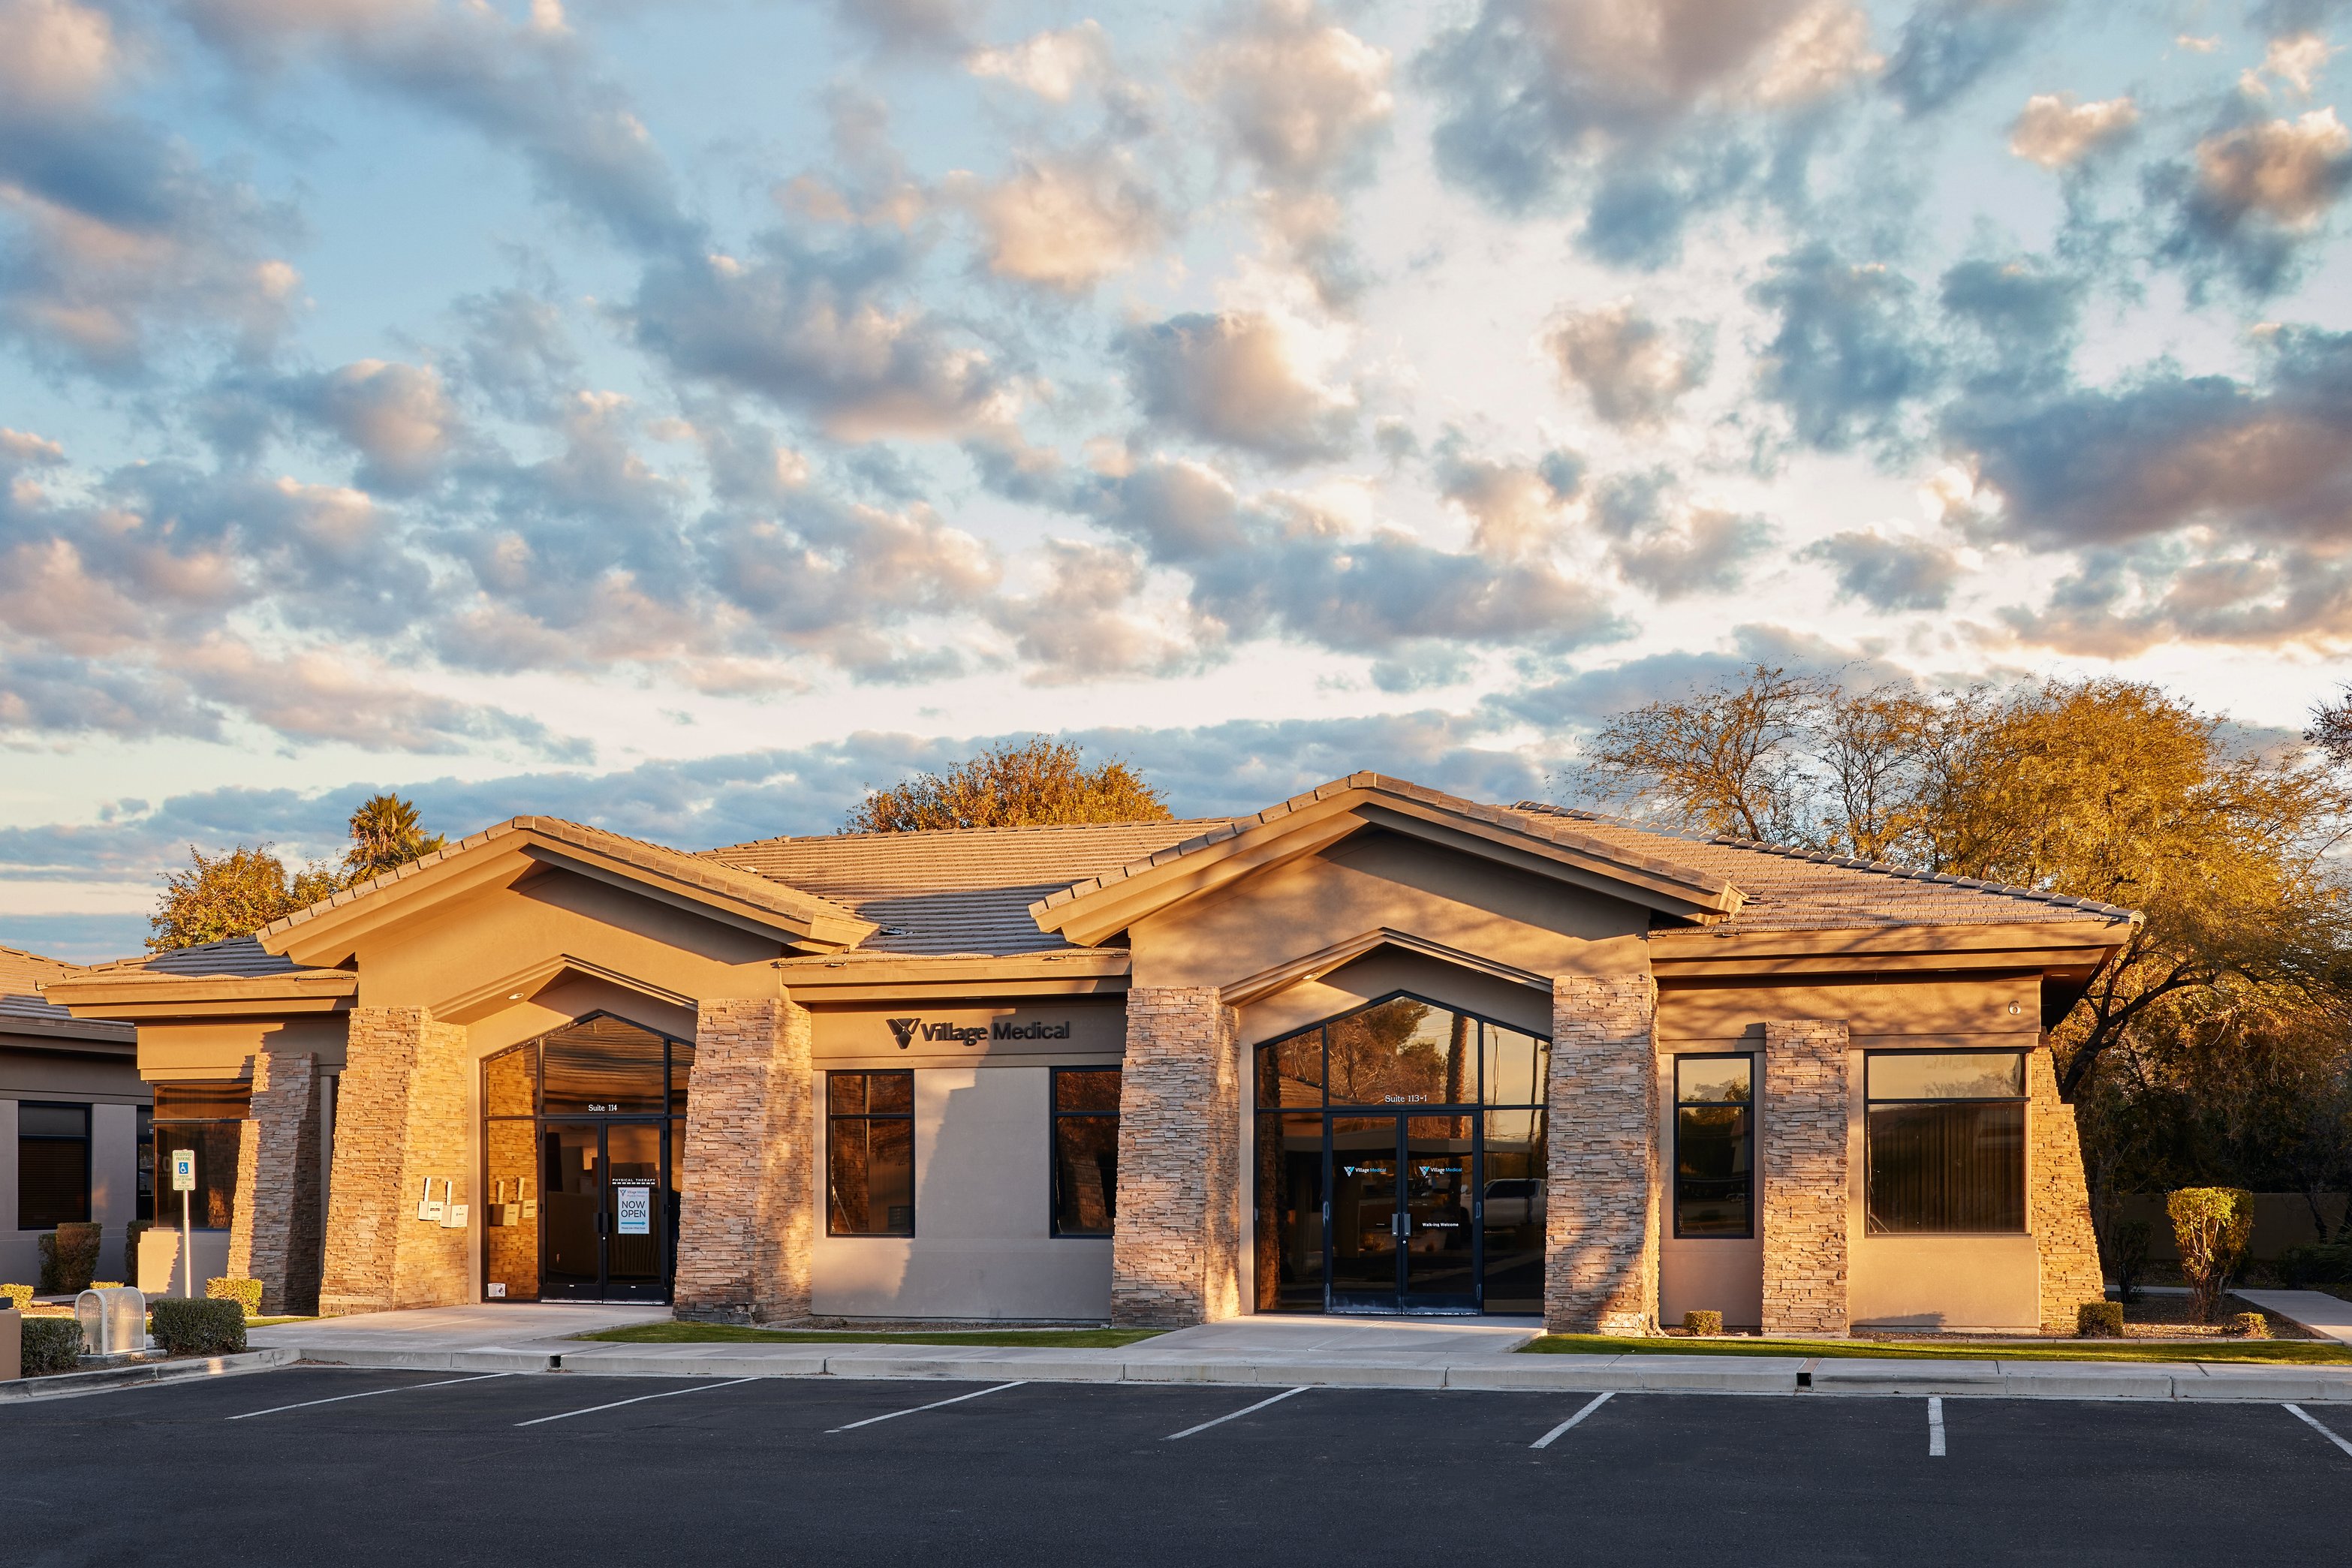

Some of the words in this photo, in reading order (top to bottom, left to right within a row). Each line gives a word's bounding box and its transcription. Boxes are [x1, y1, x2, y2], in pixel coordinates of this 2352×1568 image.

[2008, 1001, 2021, 1015] 6
[920, 1022, 988, 1046] Village
[992, 1021, 1070, 1040] Medical
[1384, 1094, 1405, 1103] Suite
[1408, 1094, 1427, 1103] 113-1
[621, 1209, 646, 1217] OPEN
